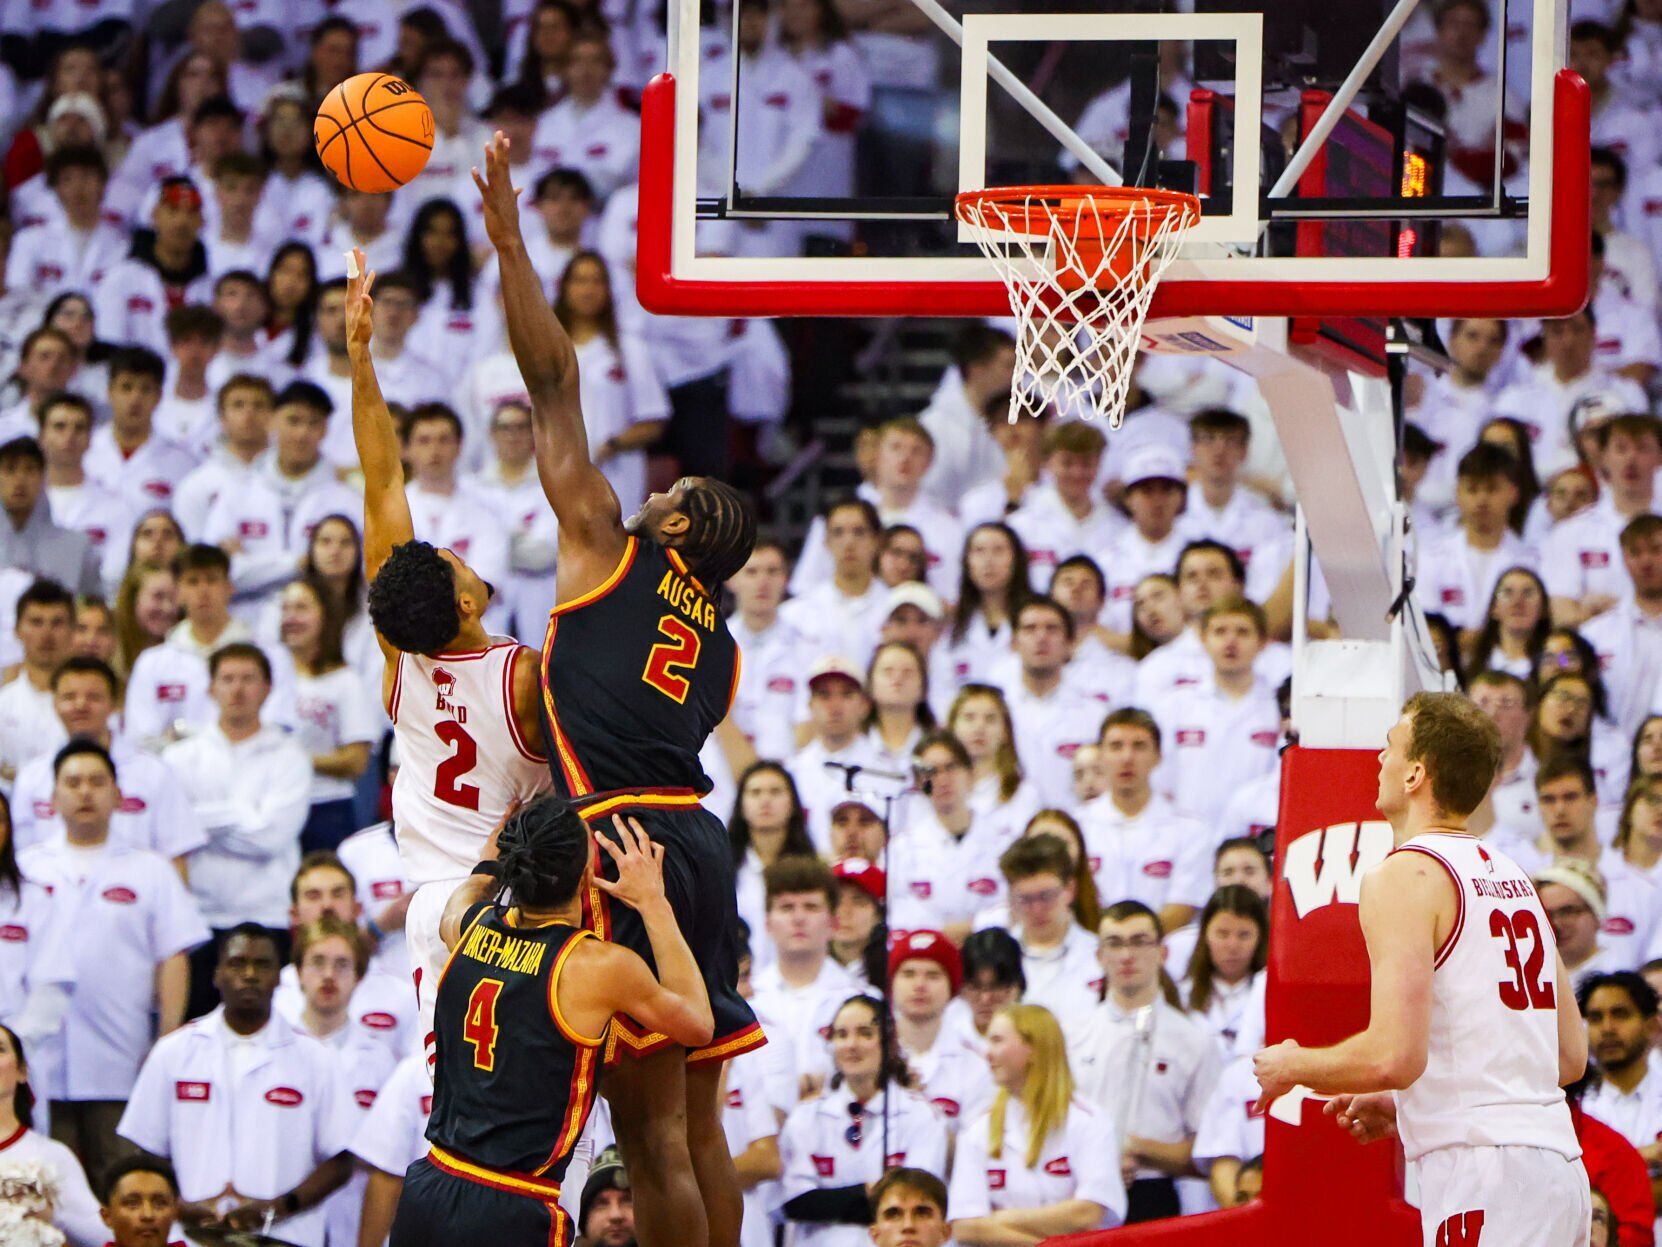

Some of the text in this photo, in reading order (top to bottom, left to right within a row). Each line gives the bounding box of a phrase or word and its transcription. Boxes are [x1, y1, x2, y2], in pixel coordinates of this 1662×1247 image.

[657, 569, 715, 632] AUSAR
[642, 614, 701, 705] 2
[434, 720, 480, 812] 2
[1489, 908, 1557, 1011] 32
[463, 977, 505, 1072] 4
